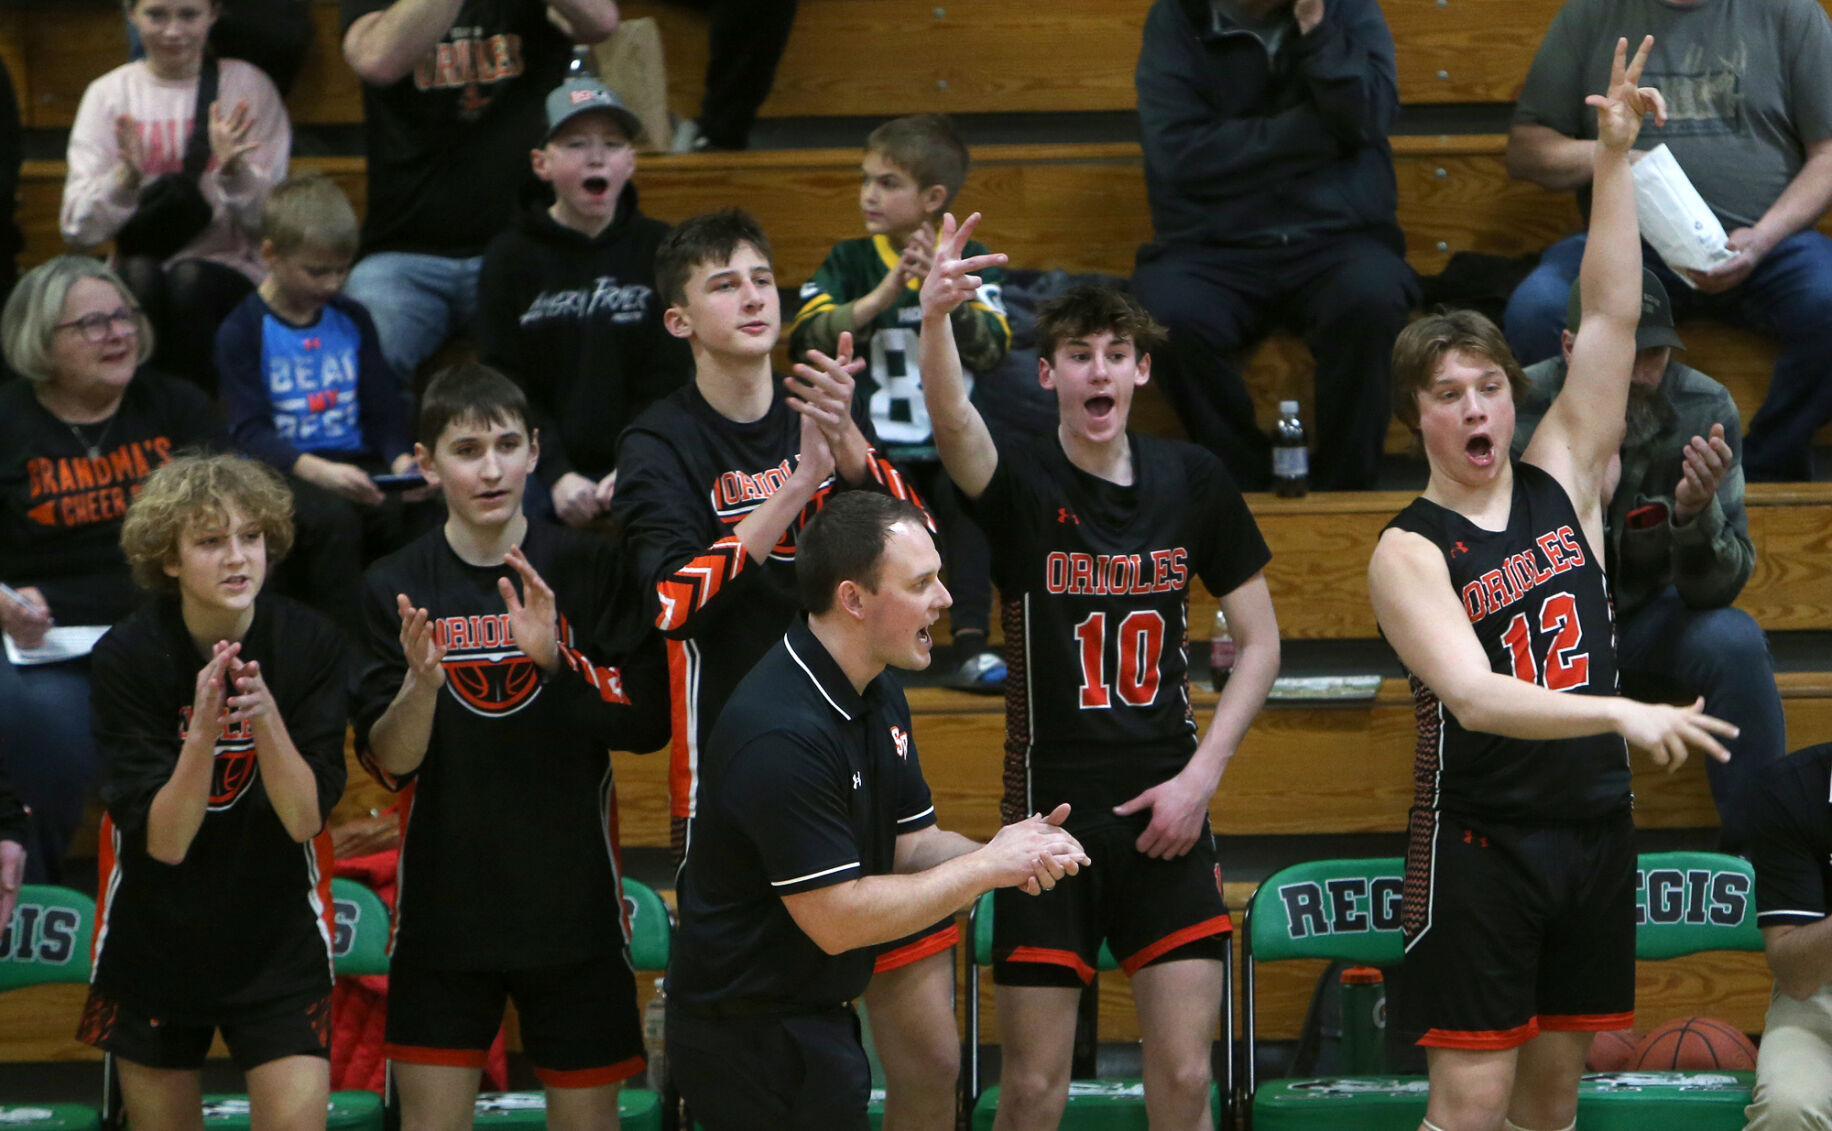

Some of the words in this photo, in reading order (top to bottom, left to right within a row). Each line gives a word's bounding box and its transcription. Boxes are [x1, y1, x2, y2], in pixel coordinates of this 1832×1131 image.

[869, 328, 974, 443] 8
[1046, 547, 1188, 595] ORIOLES
[1462, 525, 1585, 624] ORIOLES
[436, 613, 517, 650] ORIOL
[1074, 609, 1166, 709] 10
[1500, 591, 1589, 691] 12
[1278, 876, 1404, 939] REG
[1636, 868, 1752, 927] GIS
